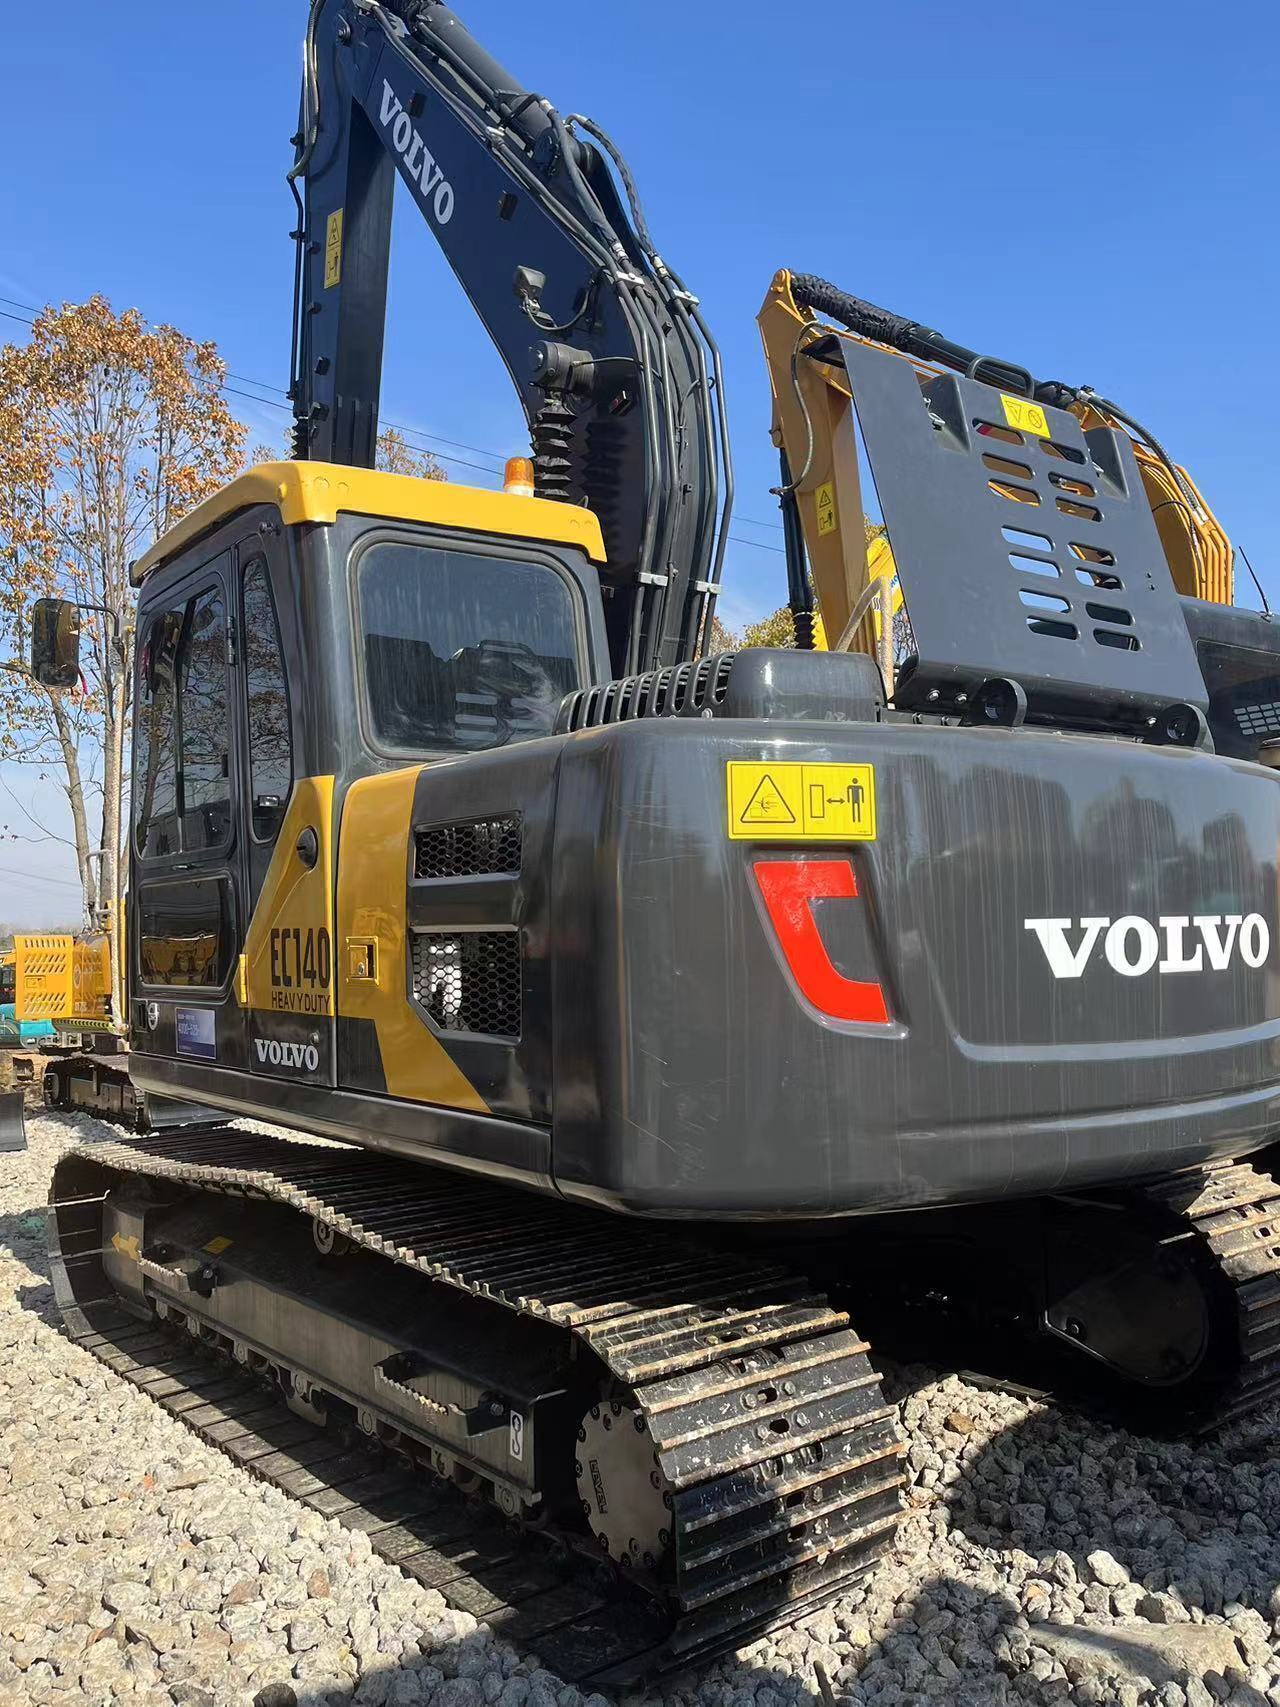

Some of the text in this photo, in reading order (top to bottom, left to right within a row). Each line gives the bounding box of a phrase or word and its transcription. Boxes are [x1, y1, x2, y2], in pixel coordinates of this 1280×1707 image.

[379, 78, 455, 225] VOLVO
[270, 926, 331, 989] EC140
[1024, 912, 1270, 979] VOLVO
[254, 1037, 320, 1071] VOLVO
